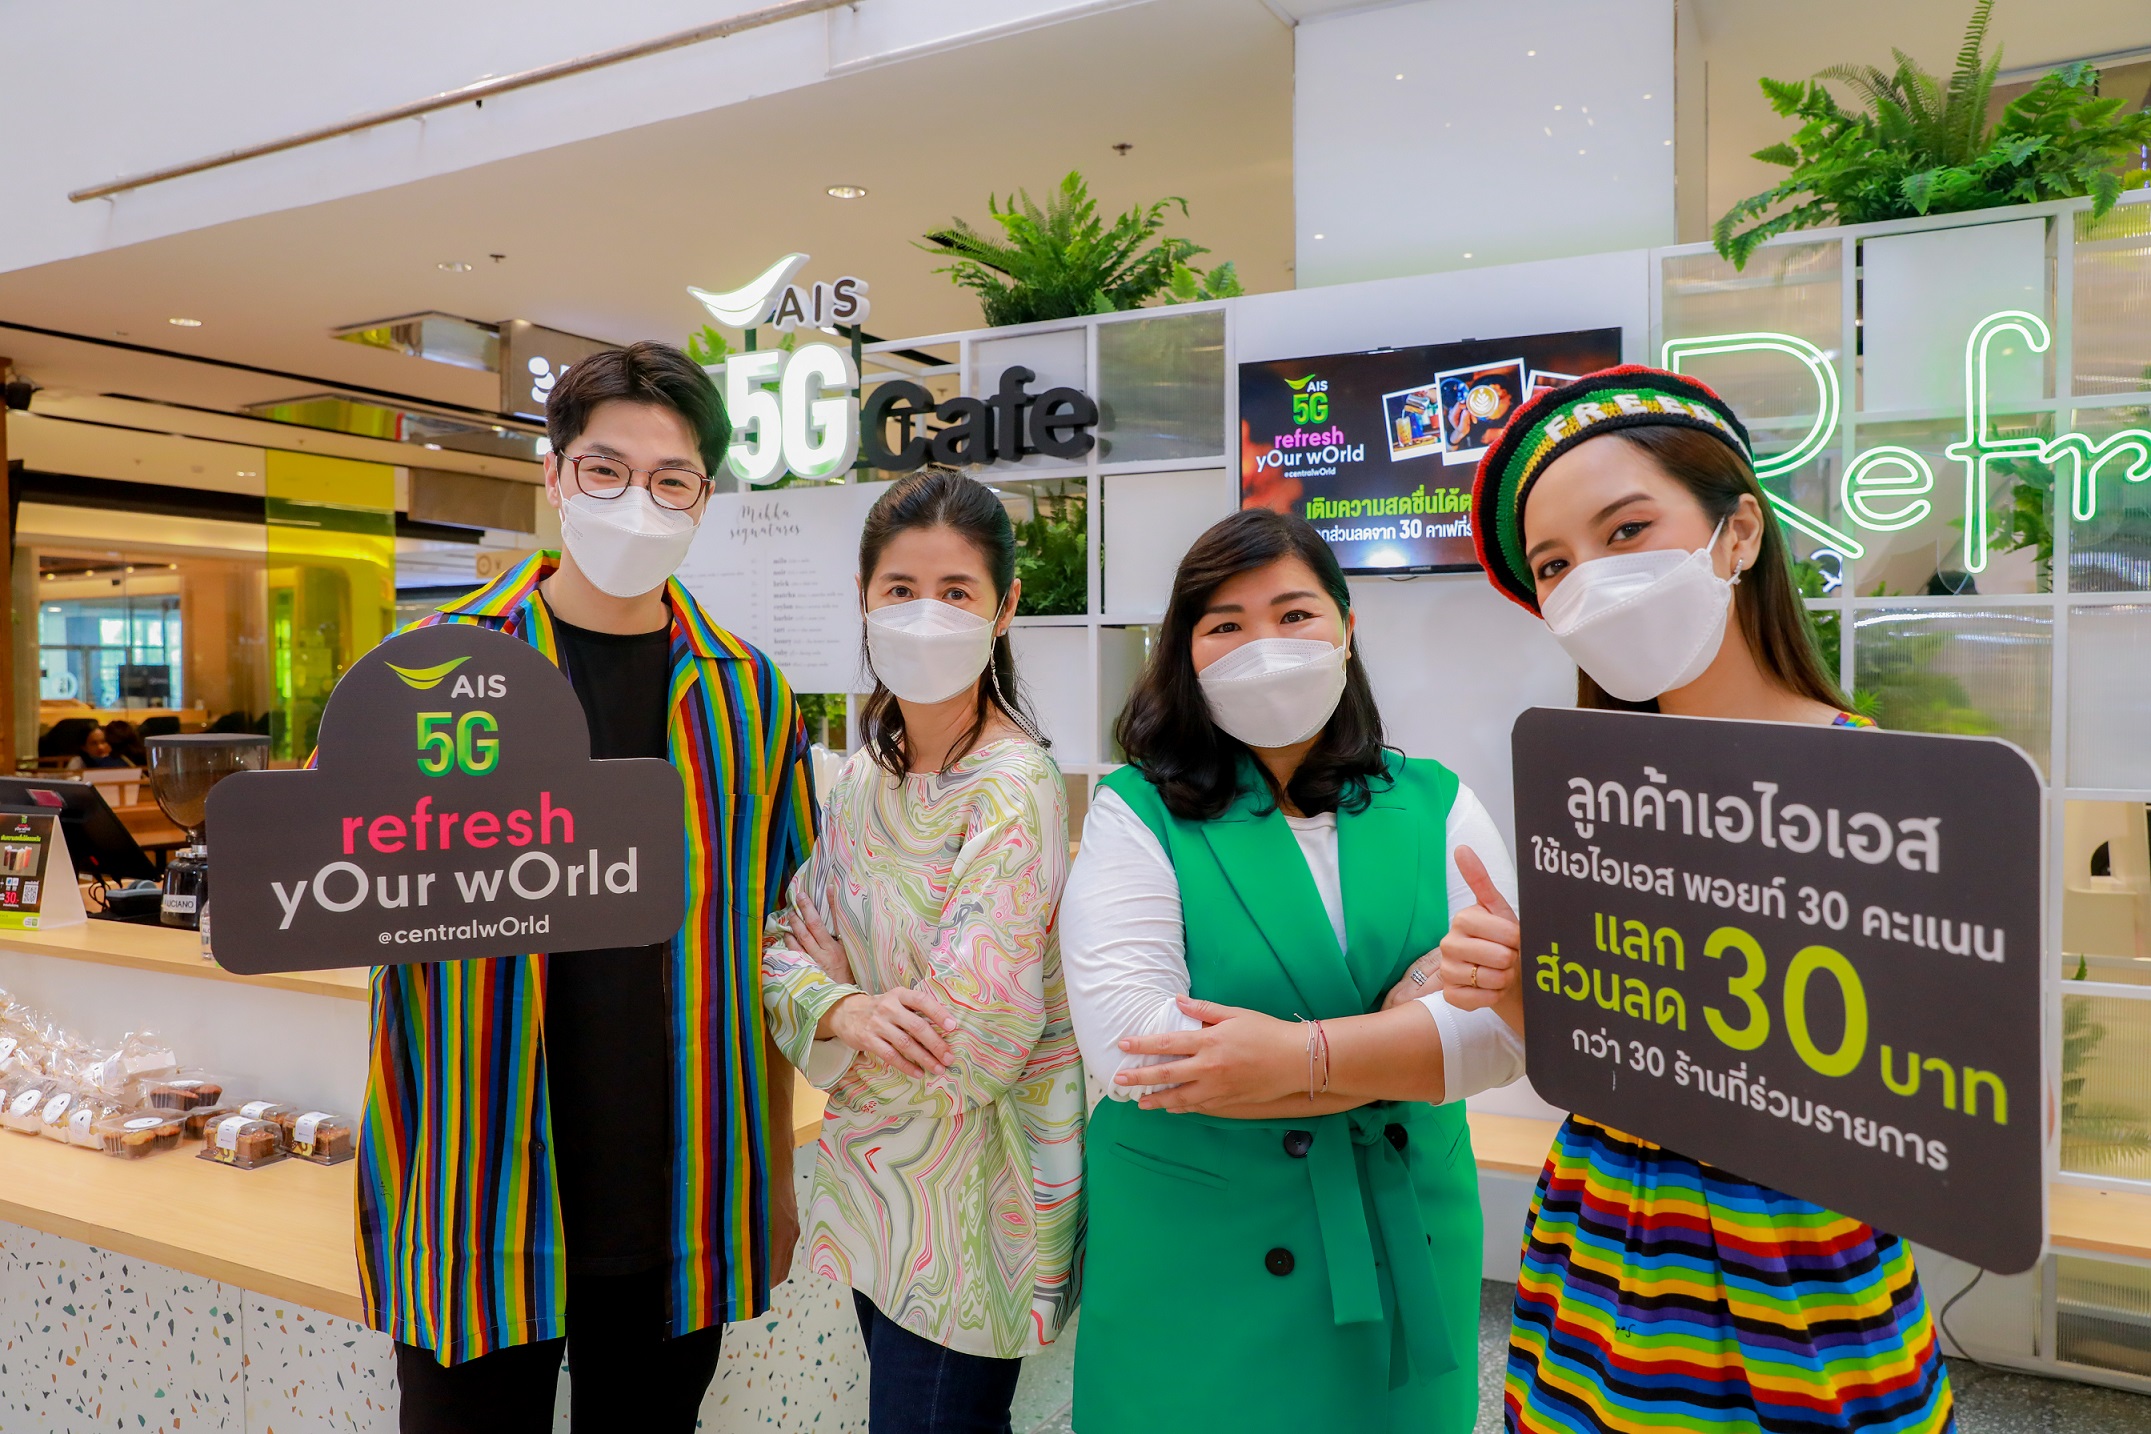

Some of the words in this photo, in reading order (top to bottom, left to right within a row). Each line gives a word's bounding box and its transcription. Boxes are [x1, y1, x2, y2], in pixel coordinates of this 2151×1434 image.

[774, 277, 864, 331] AIS
[726, 342, 858, 485] 5G
[861, 365, 1099, 472] Cafe
[1292, 391, 1329, 425] 5G
[1306, 380, 1329, 392] AIS
[1274, 425, 1344, 449] refresh
[1399, 519, 1422, 539] 30
[451, 675, 507, 699] AIS
[416, 711, 500, 777] 5G
[342, 792, 574, 855] refresh
[1566, 766, 1942, 874] ลูกค้าเอไอเอส
[271, 861, 436, 930] yOur
[454, 847, 639, 904] wOrld
[1530, 836, 1675, 897] ใช้เอไอเอส
[1683, 872, 1787, 919] พอยท์
[1797, 886, 1849, 930] 30
[1862, 904, 2006, 963] คะแนน
[1594, 912, 1685, 971] แลก
[1535, 942, 1687, 1031] ส่วนลด
[1702, 926, 1868, 1077] 30
[1880, 1044, 2008, 1125] บาท
[1572, 1027, 1621, 1064] กว่า
[1628, 1041, 1665, 1077] 30
[1674, 1048, 1950, 1171] ร้านที่ร่วมรายการ
